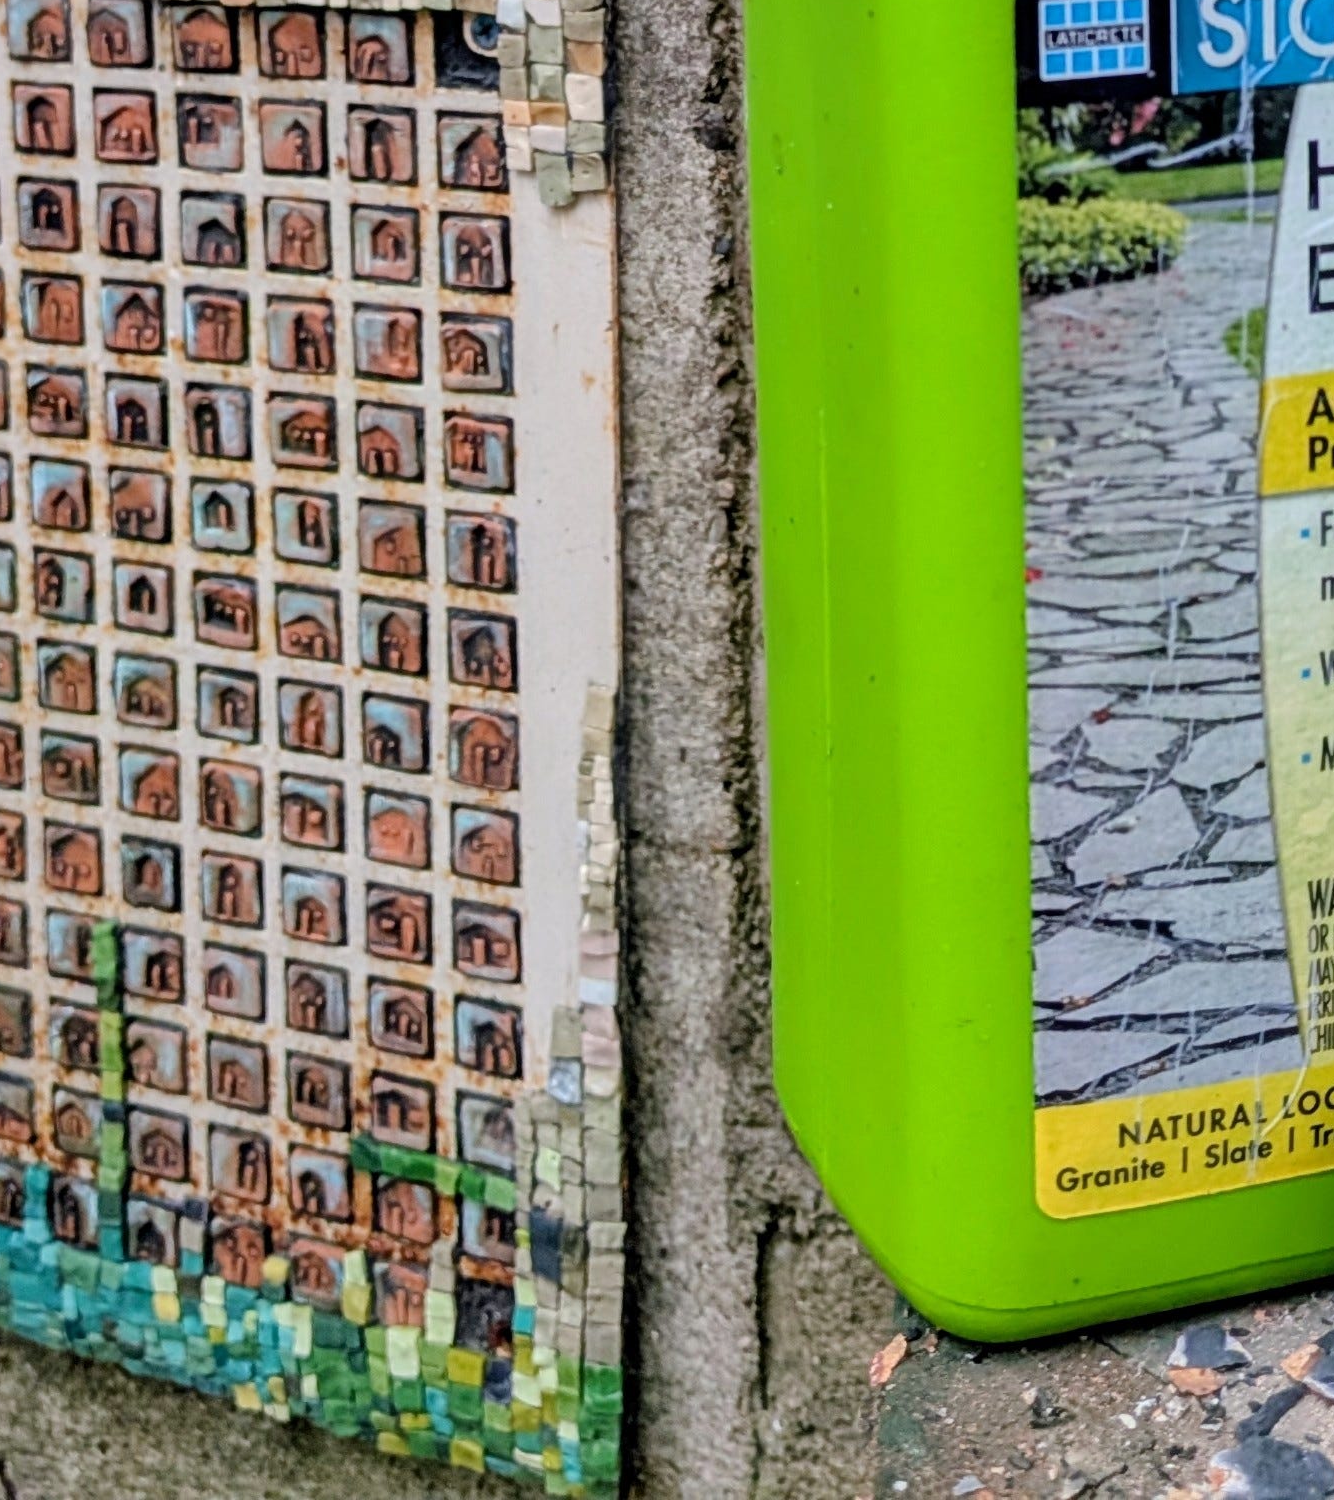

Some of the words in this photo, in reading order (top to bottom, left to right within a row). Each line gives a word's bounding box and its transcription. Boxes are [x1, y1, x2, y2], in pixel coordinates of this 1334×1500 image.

[1047, 26, 1140, 49] LATICRETE
[1309, 924, 1328, 952] OR
[1119, 1102, 1267, 1148] NATURAL
[1057, 1156, 1165, 1192] Granite
[1205, 1139, 1273, 1169] Slate
